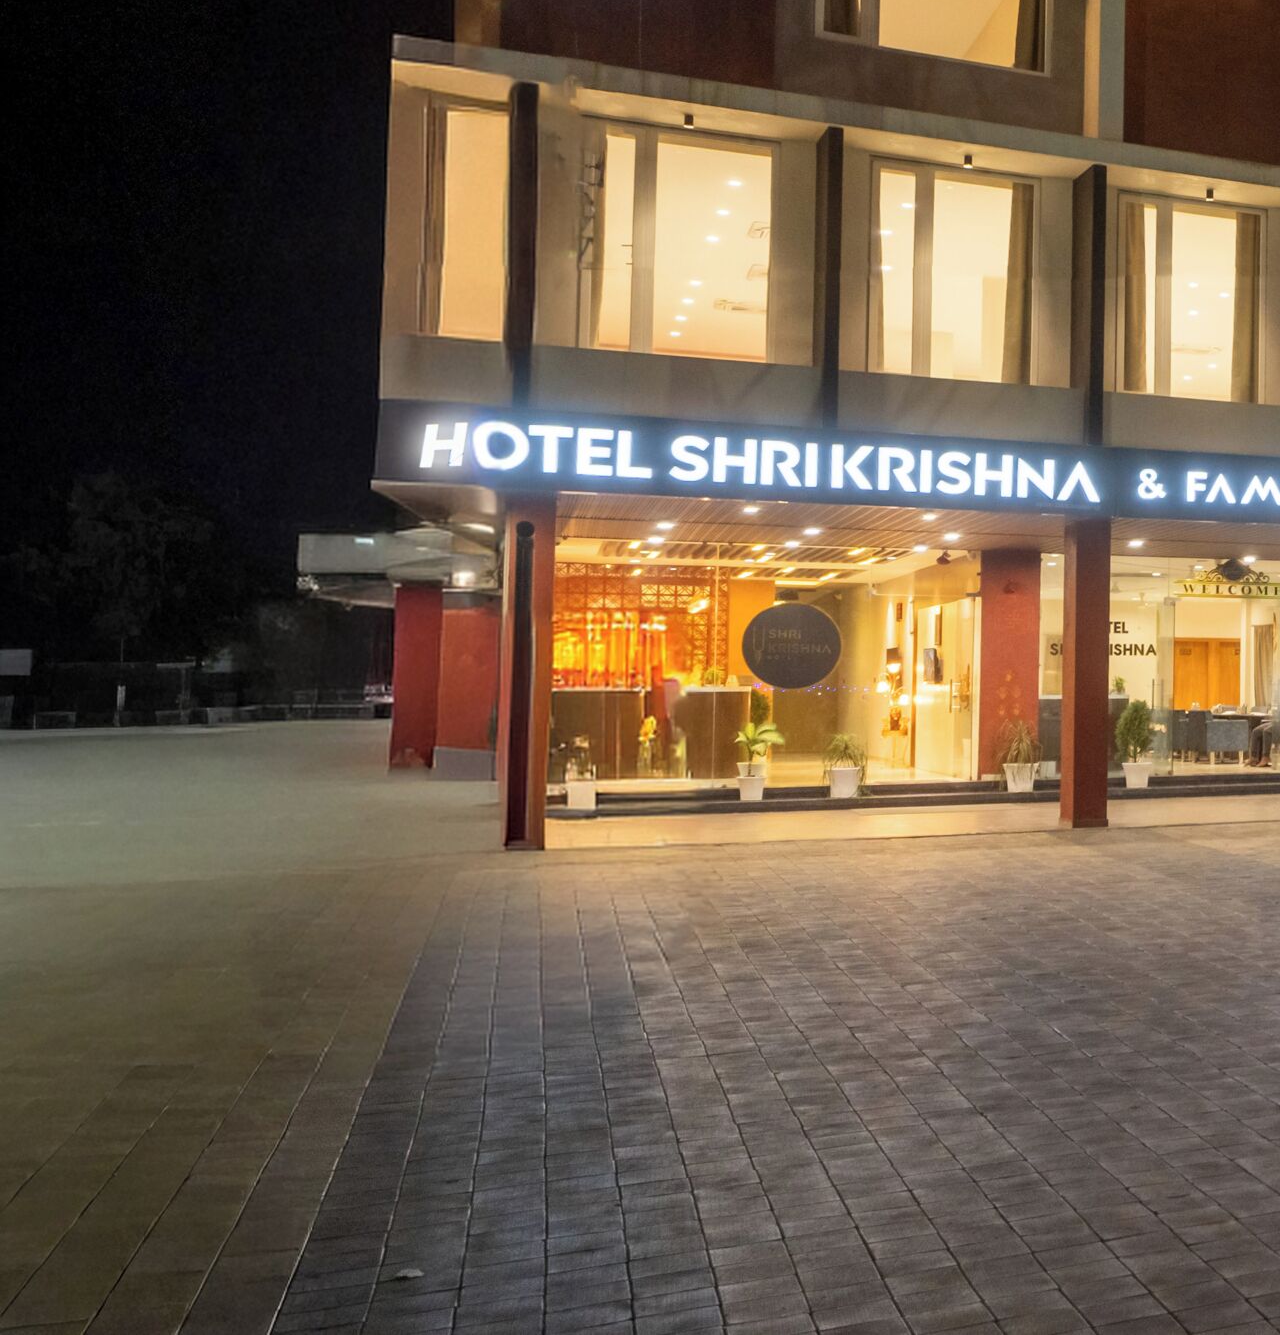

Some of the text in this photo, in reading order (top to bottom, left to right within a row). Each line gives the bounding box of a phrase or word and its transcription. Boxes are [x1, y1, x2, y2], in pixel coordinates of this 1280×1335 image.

[419, 420, 652, 479] HOTEL
[669, 434, 818, 489] SHRI
[829, 445, 1101, 503] KRISHNA
[1138, 468, 1166, 500] &
[1108, 620, 1129, 634] TEL
[1109, 643, 1157, 656] ISHNA
